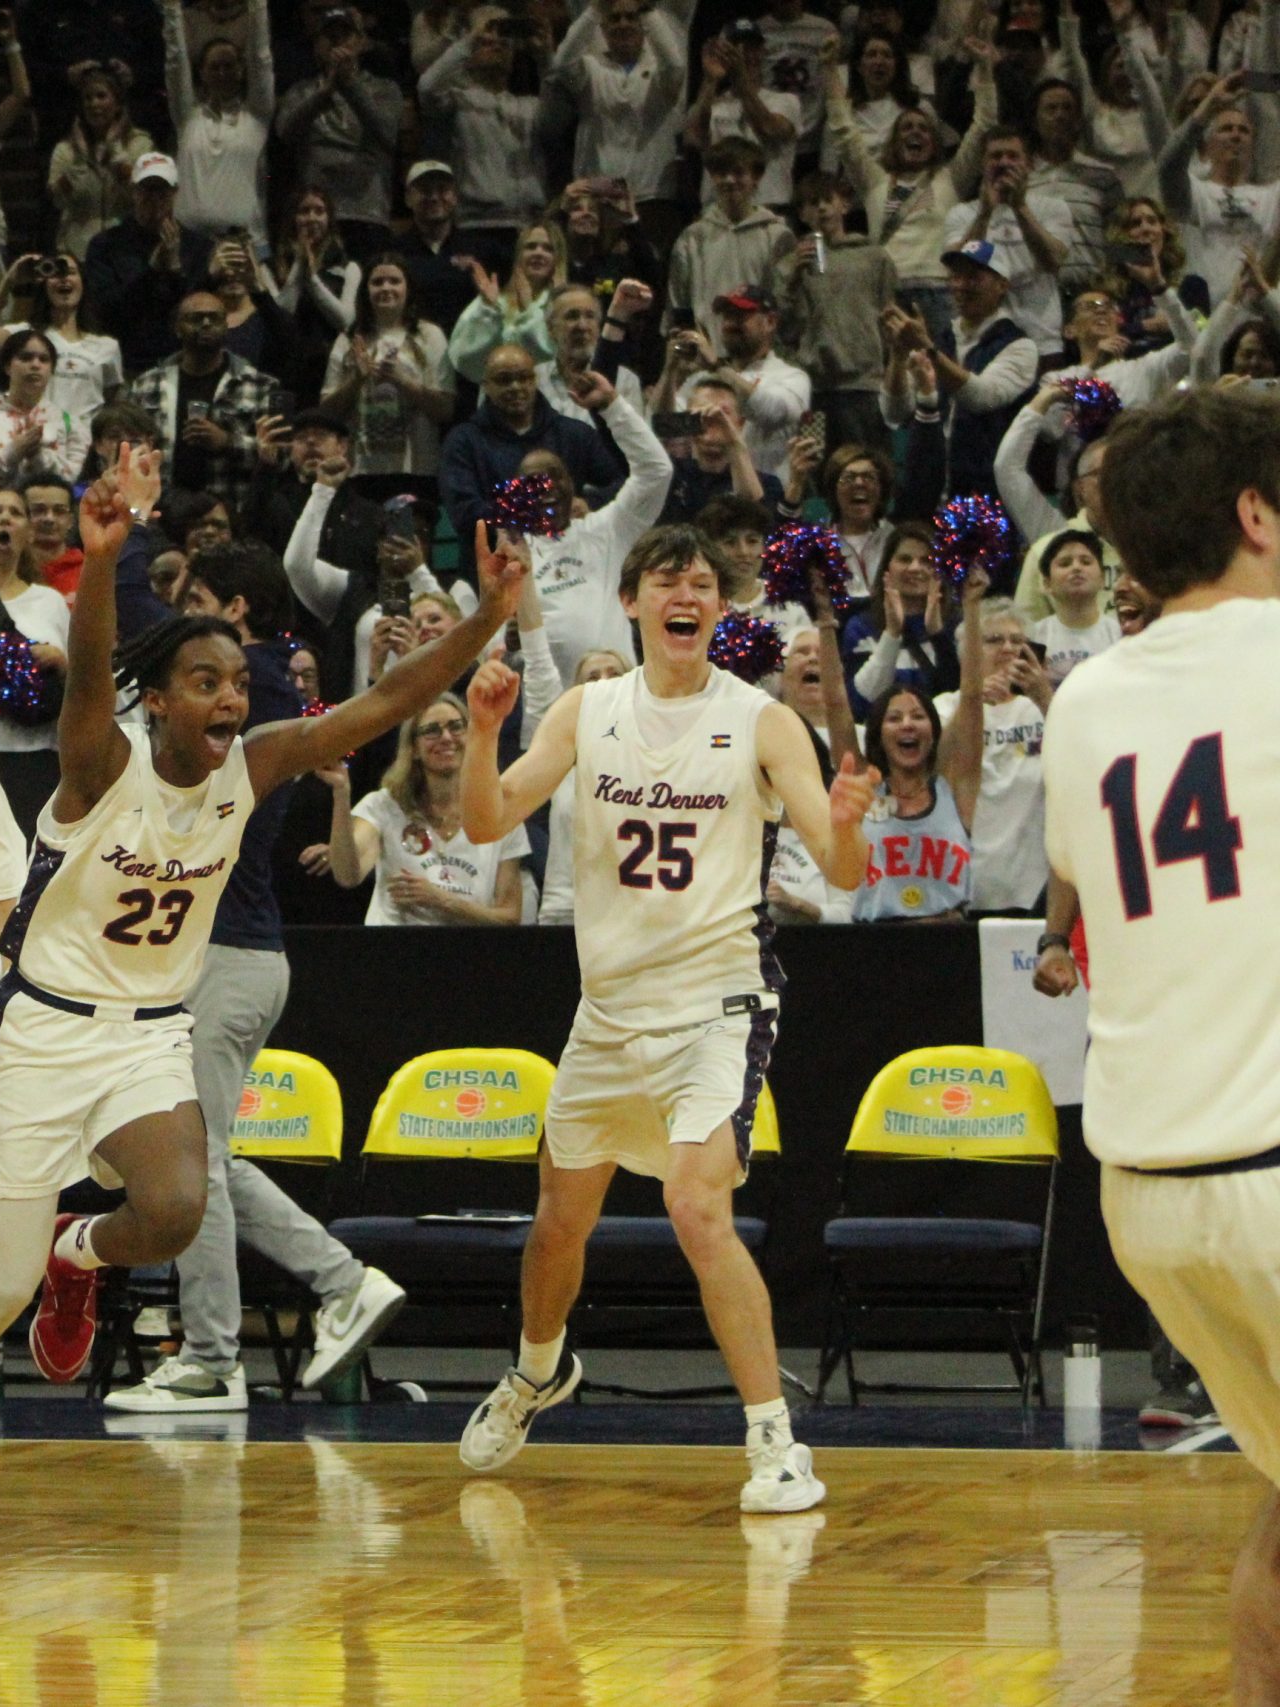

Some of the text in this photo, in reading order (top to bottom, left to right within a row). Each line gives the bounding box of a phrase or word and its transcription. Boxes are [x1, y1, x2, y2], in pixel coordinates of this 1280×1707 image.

[535, 561, 552, 580] KENT
[996, 721, 1044, 745] DENVE
[594, 774, 729, 810] Kent Denver
[1099, 731, 1245, 923] 14
[101, 844, 158, 878] Kent
[441, 855, 478, 878] DENVER
[616, 818, 697, 892] 25
[102, 887, 195, 946] 23
[1011, 949, 1038, 971] Ke
[243, 1071, 294, 1092] SAA
[424, 1070, 518, 1090] CHSAA
[909, 1067, 1006, 1089] CHSAA
[234, 1115, 308, 1138] MPIONSHIPS
[399, 1112, 536, 1138] STATE CHAMPIONSHIPS
[884, 1109, 1025, 1137] STATE CHAMPIONSHIPS
